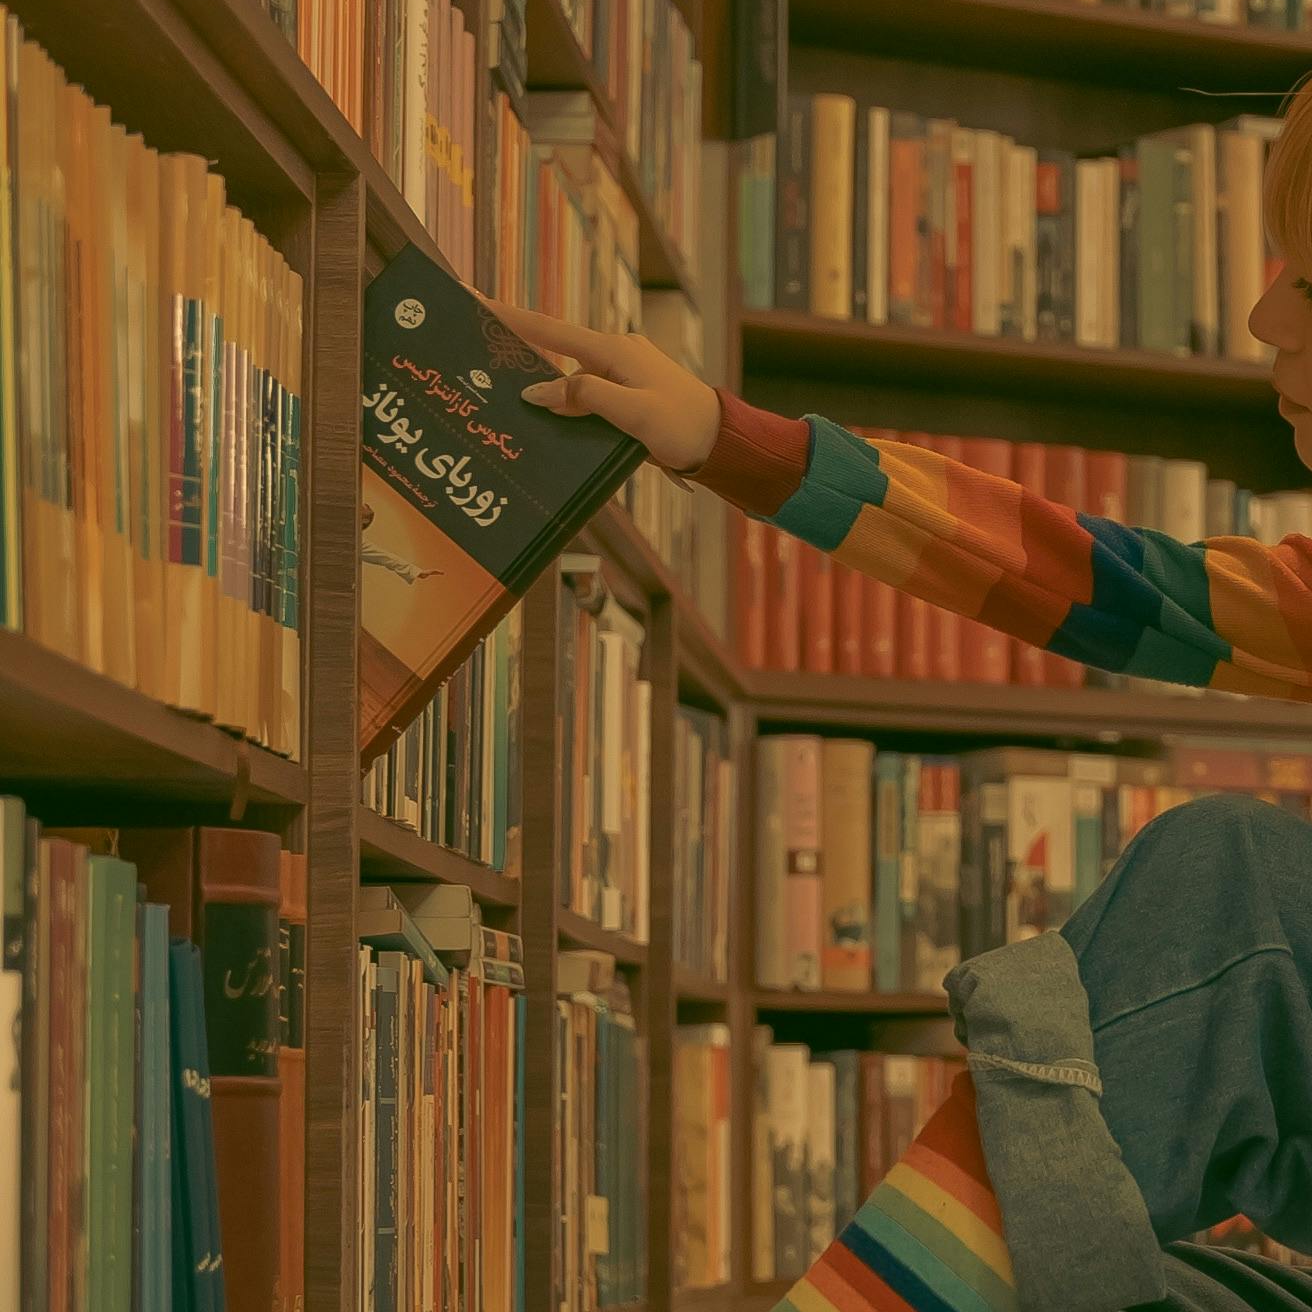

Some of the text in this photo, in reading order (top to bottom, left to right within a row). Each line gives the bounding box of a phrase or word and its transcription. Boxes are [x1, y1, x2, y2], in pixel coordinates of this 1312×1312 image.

[399, 315, 417, 325] نهم
[403, 304, 424, 317] چاپ
[392, 355, 479, 416] کازانتزاکیس
[466, 419, 524, 460] نیکوس
[415, 448, 508, 526] زوربای
